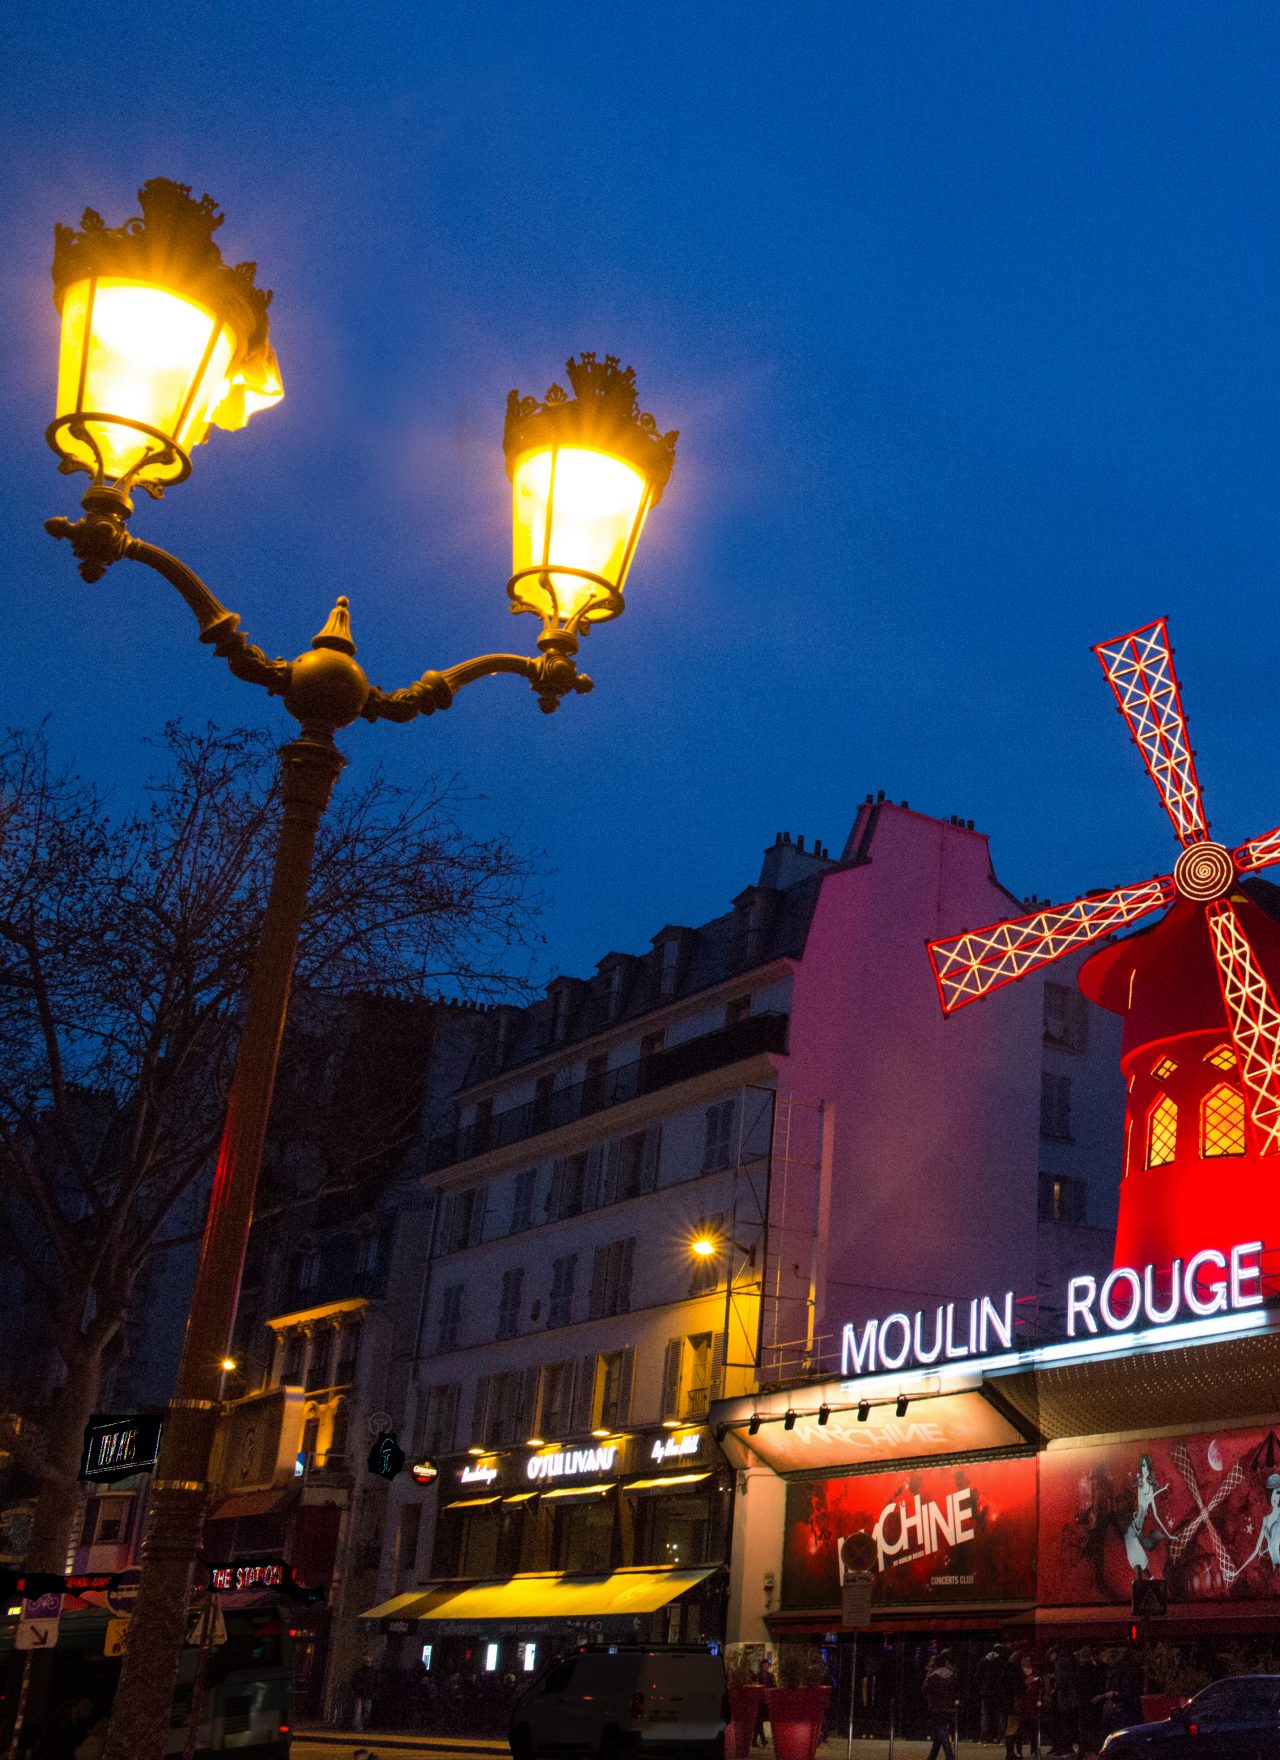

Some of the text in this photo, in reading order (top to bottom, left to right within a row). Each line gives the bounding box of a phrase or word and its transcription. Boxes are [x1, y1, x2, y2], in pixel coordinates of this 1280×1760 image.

[841, 1240, 1265, 1376] MOULIN ROUGE
[212, 1568, 234, 1589] THE
[930, 1575, 959, 1586] CONCERTS
